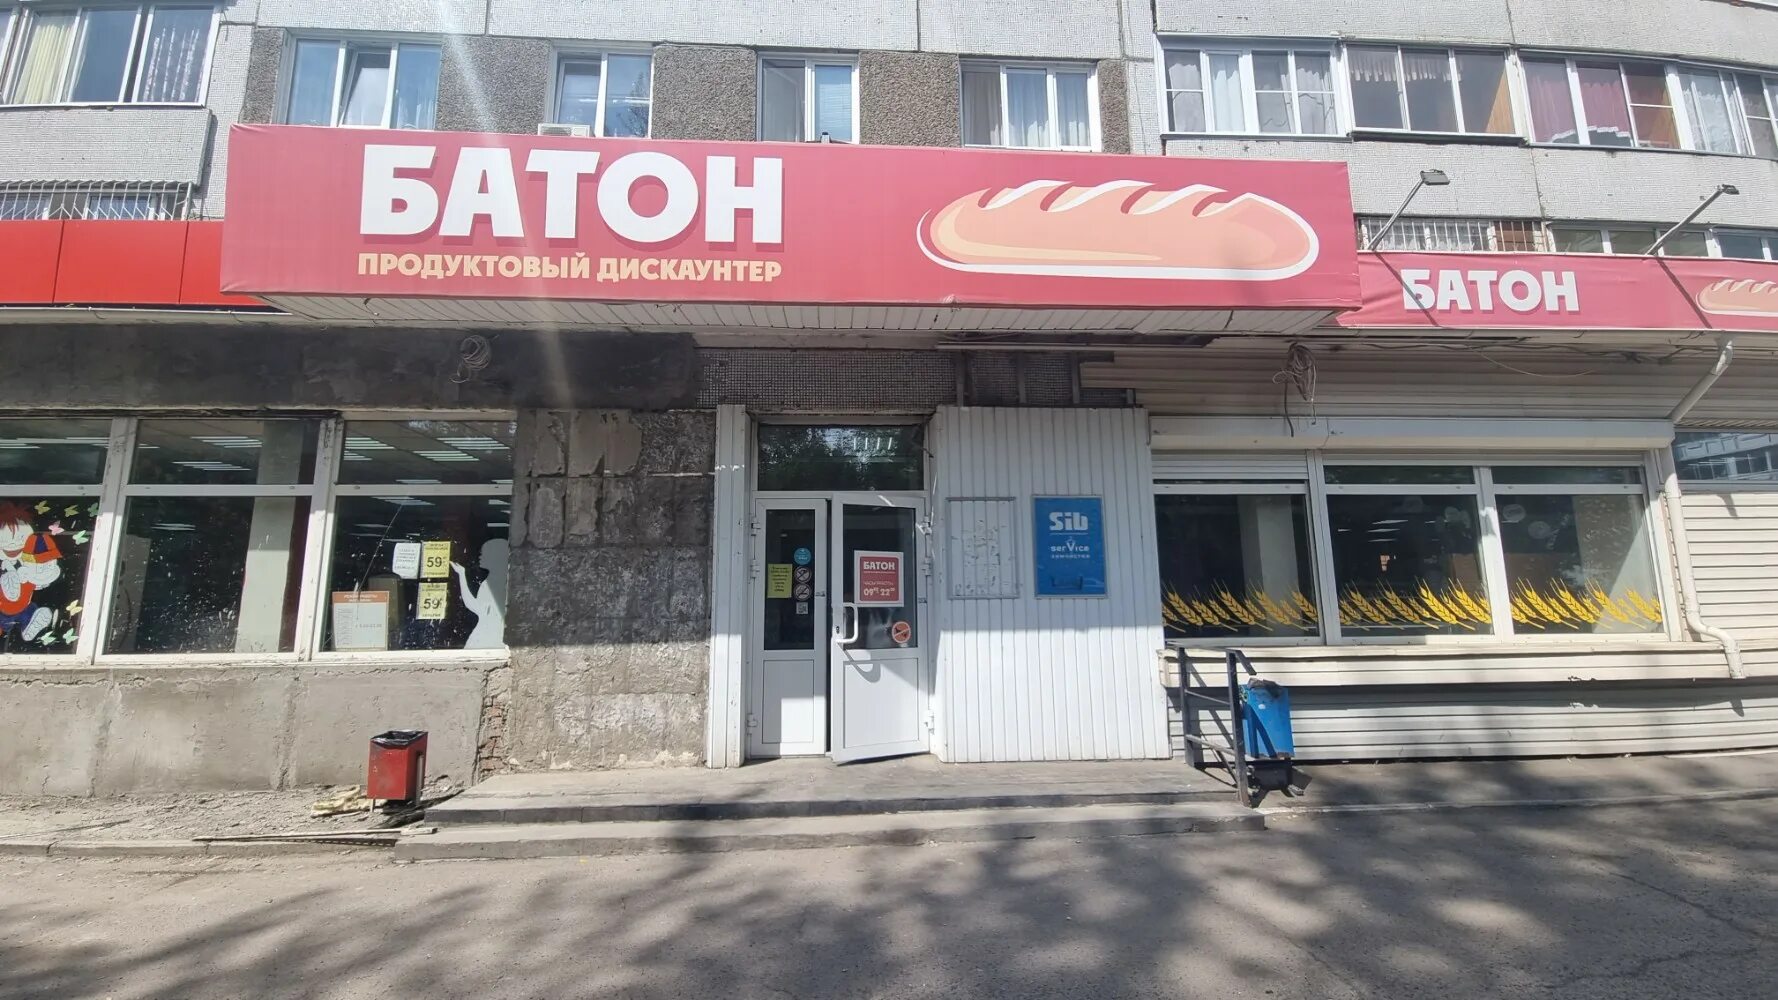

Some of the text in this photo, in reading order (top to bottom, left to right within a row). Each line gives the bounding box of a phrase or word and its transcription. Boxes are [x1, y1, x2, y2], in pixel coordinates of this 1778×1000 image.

[360, 144, 783, 243] БАТОН
[358, 251, 782, 283] ПРОДУКТОВЫЙ ДИСКАУНТЕР
[1401, 269, 1579, 311] БАТОН
[1049, 512, 1088, 530] Sib
[863, 561, 895, 570] БАТОН
